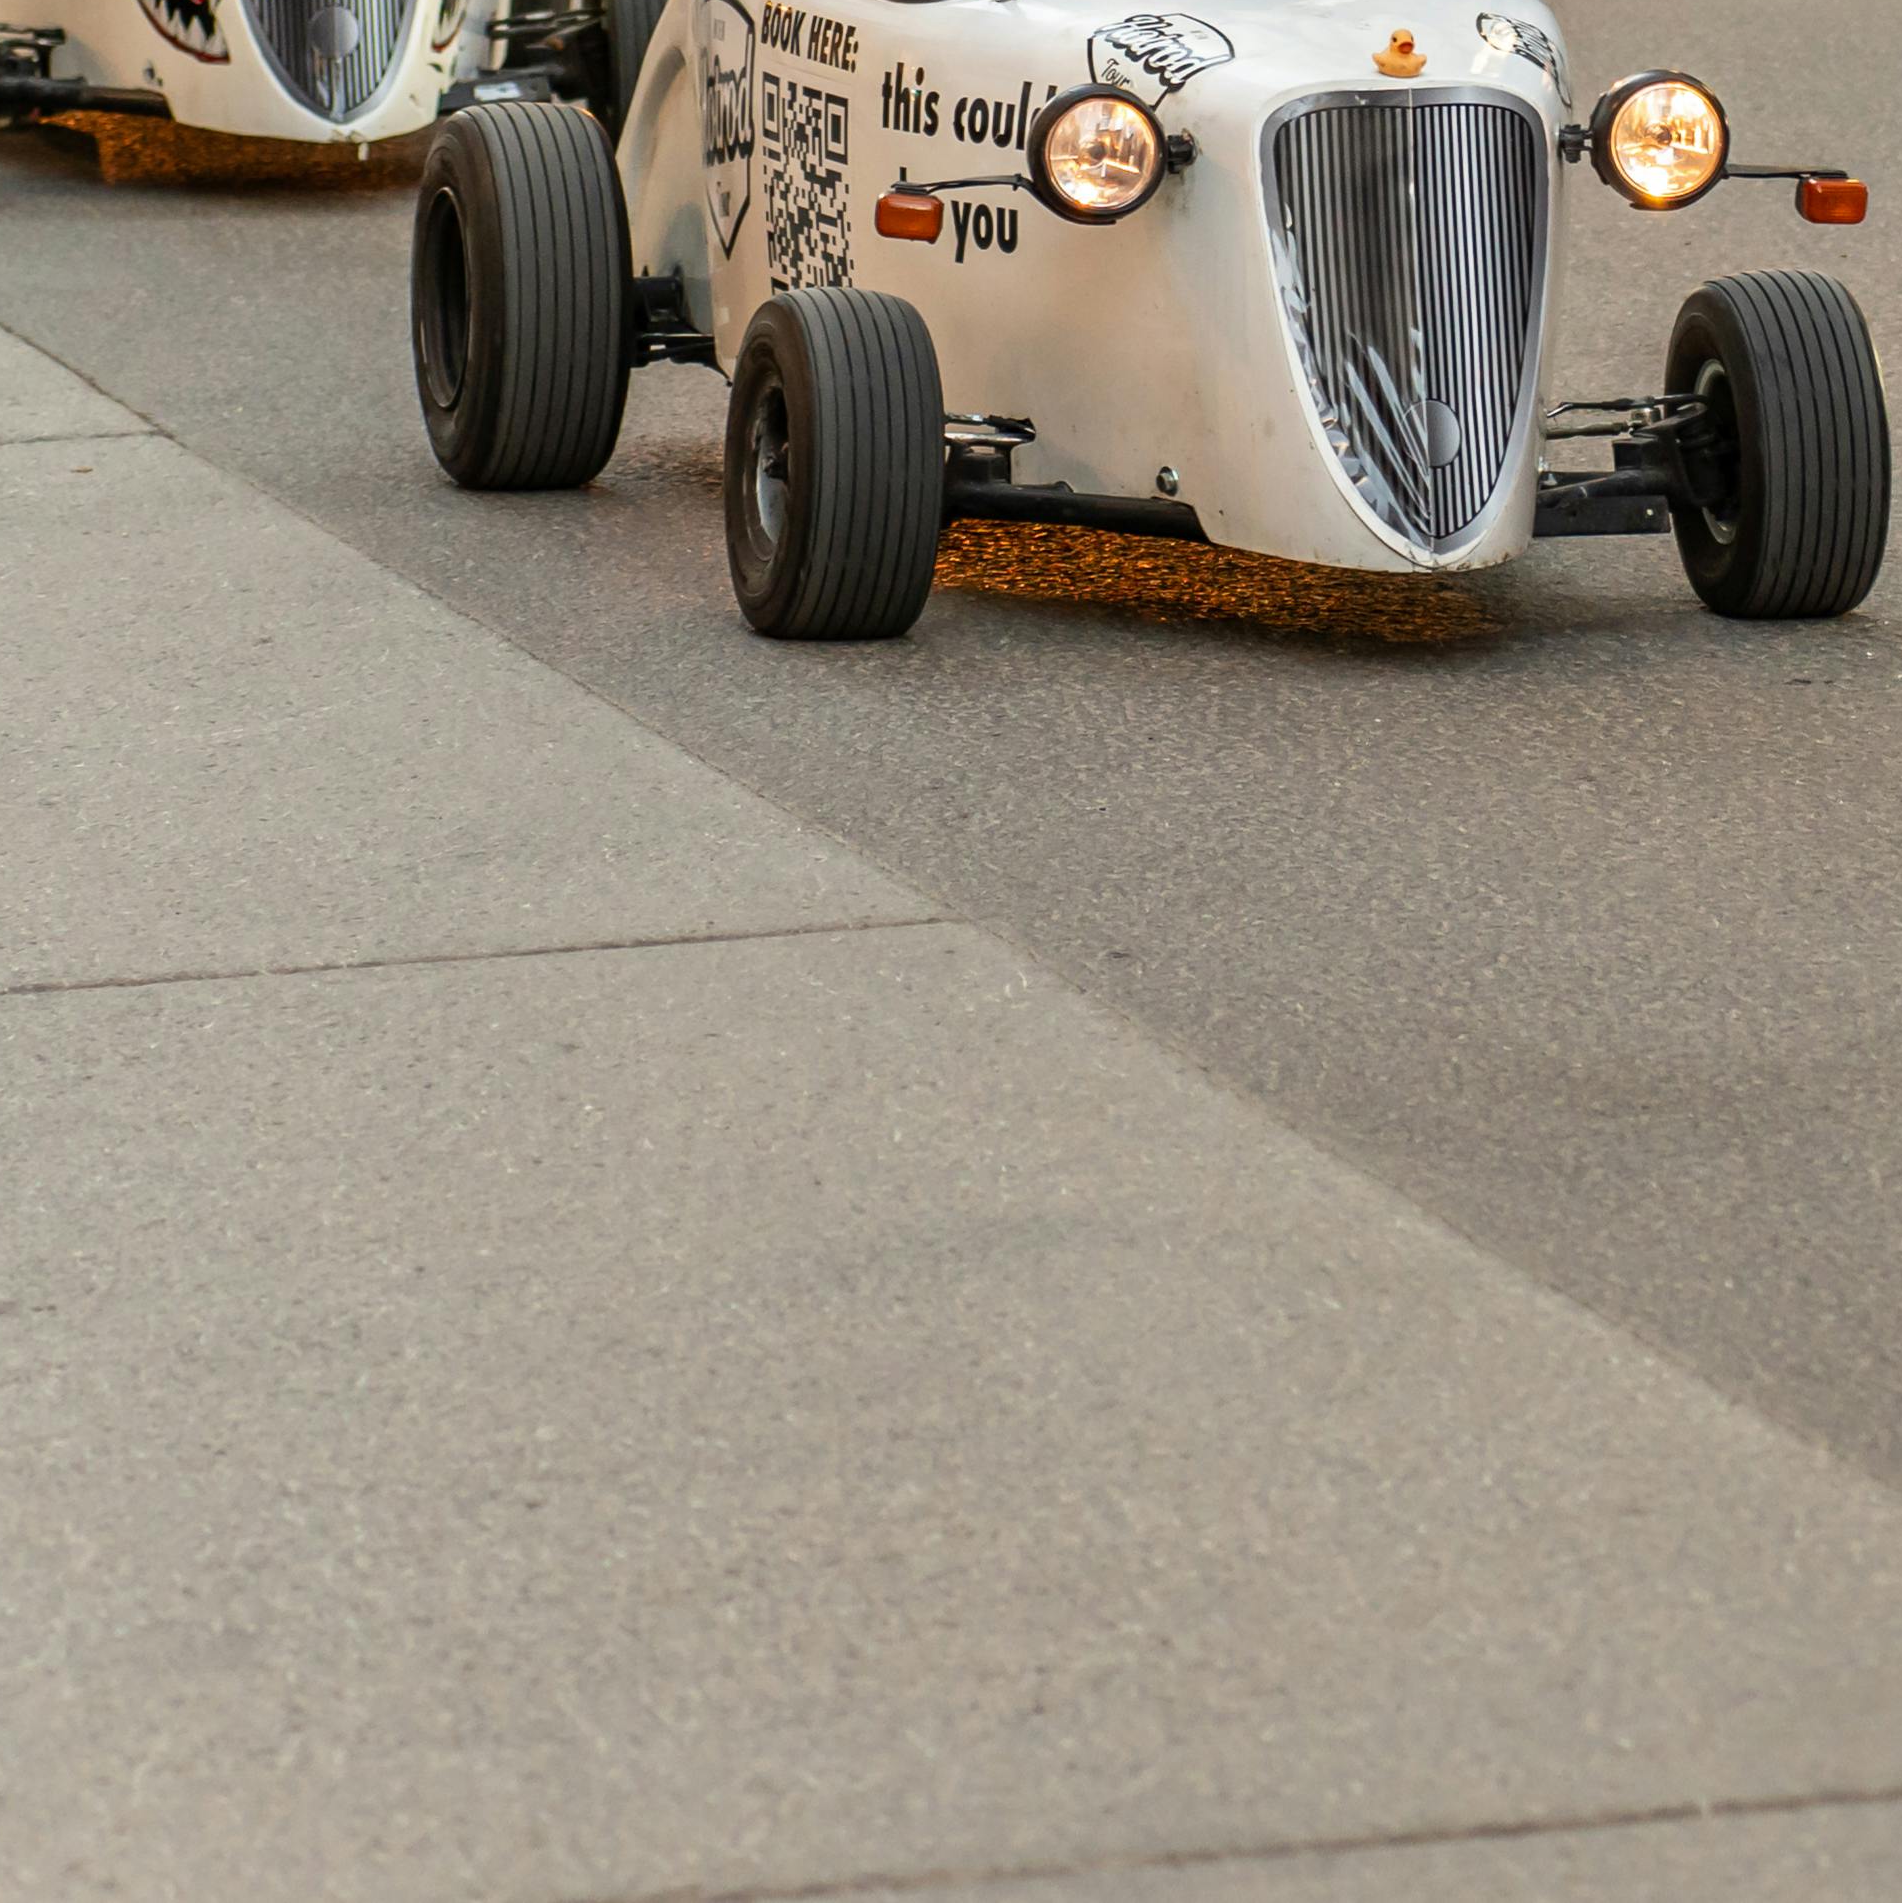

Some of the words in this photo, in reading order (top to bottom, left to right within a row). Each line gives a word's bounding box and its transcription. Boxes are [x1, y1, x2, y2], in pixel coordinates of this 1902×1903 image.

[760, 0, 806, 58] BOOK
[807, 15, 859, 74] HERE:
[881, 61, 940, 138] this
[1101, 58, 1132, 88] Tour
[951, 199, 1018, 263] you
